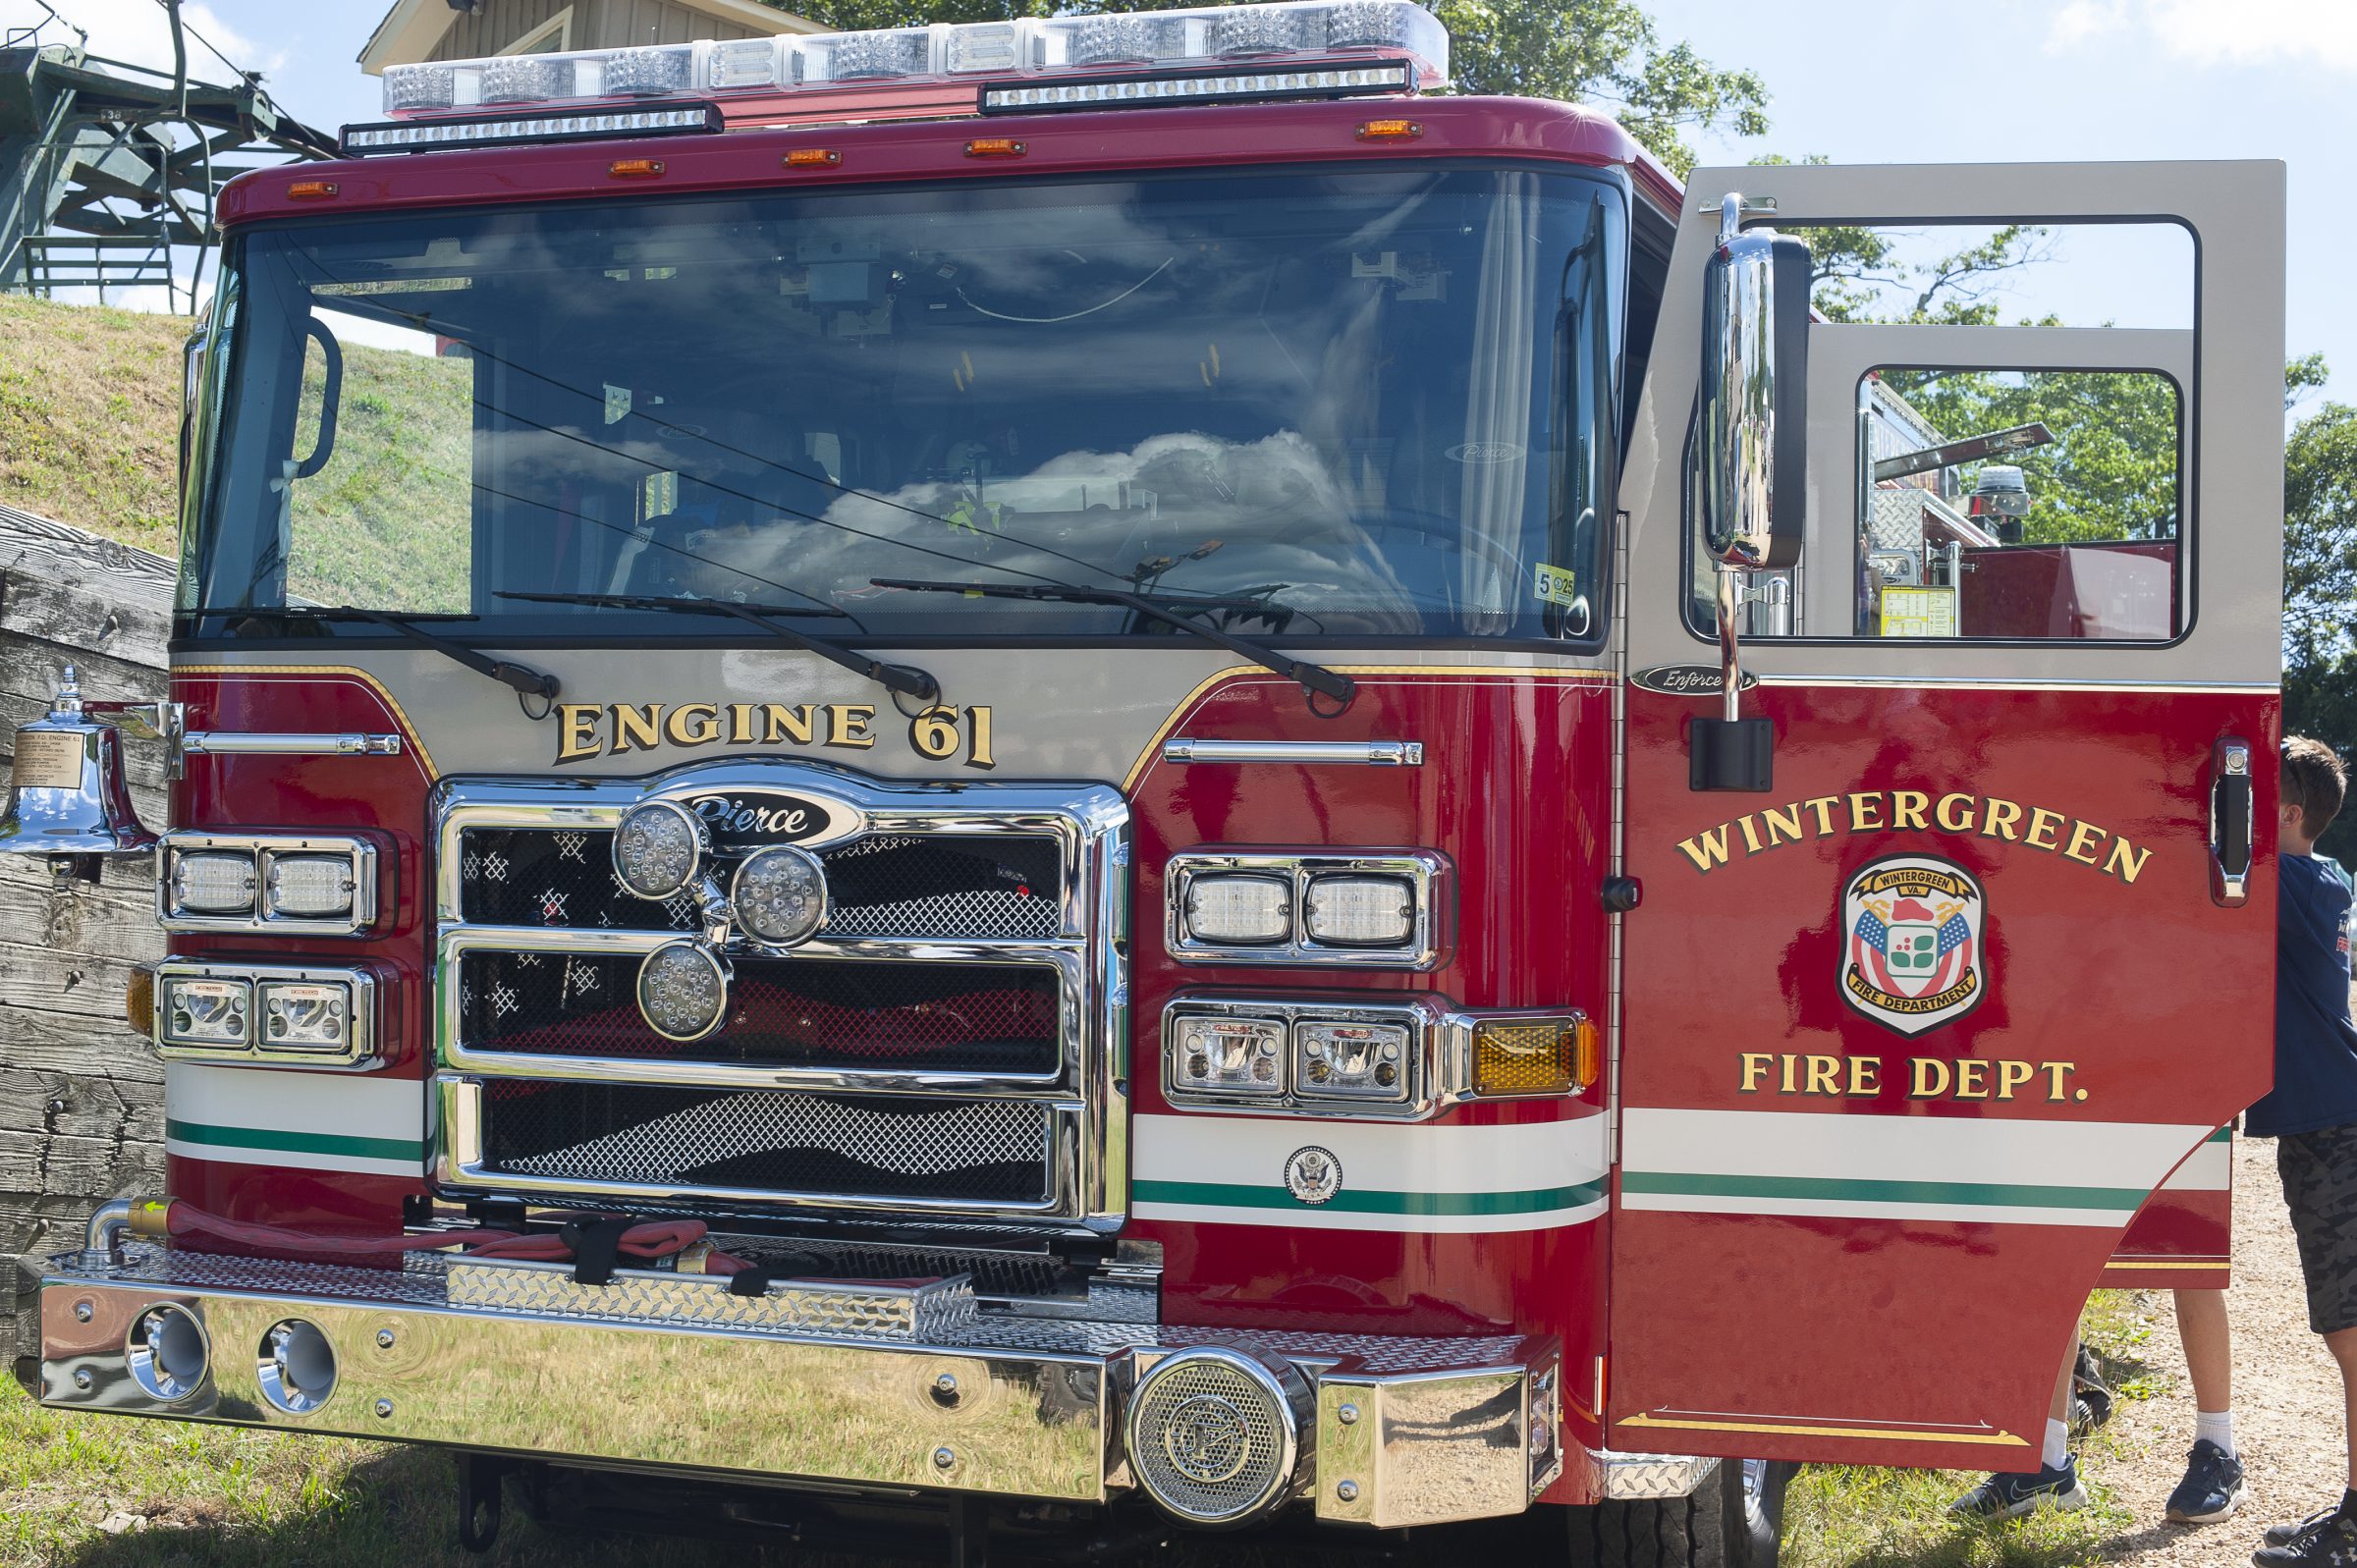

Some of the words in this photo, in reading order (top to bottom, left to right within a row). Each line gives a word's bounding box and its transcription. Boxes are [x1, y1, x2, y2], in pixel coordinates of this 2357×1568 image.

[1539, 572, 1550, 595] 5
[1562, 577, 1573, 595] 25
[1663, 670, 1724, 691] Enforce
[553, 703, 877, 767] ENGINE
[908, 703, 997, 771] 61
[691, 795, 808, 834] Pierce
[1675, 791, 2153, 884] WINTERGREEN
[1880, 871, 1950, 889] WINTERGREEN
[1852, 980, 1879, 1002] FIRE
[1884, 980, 1972, 1011] DEPARTMENT
[1737, 1053, 1882, 1098] FIRE
[1906, 1056, 2089, 1105] DEPT.
